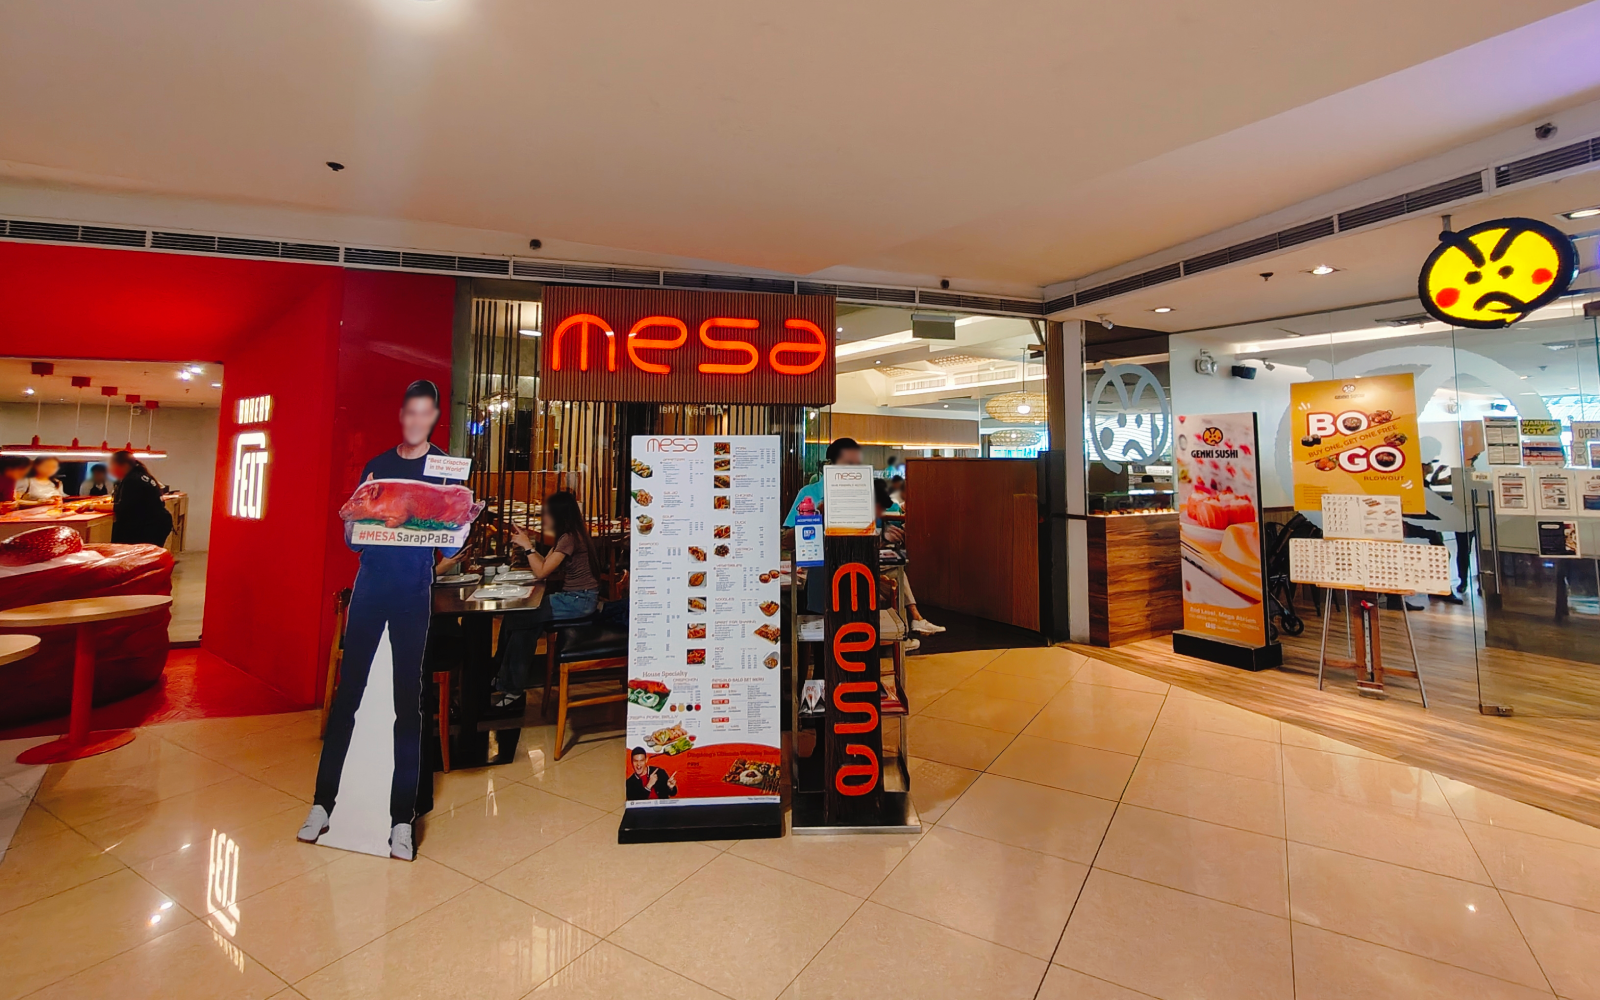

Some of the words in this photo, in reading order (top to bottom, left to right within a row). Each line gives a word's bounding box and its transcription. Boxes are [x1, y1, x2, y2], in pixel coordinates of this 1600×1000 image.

[552, 313, 827, 375] mesa
[1307, 410, 1370, 437] BO
[646, 438, 698, 452] mesa
[1191, 450, 1214, 458] GENKI
[1215, 450, 1238, 458] SUSHI
[1308, 448, 1322, 458] BUY
[1324, 444, 1343, 452] ONE,
[1344, 438, 1358, 446] GET
[1360, 432, 1376, 440] ONE
[1378, 425, 1398, 434] FREE
[1338, 445, 1406, 473] GO
[232, 432, 268, 519] FELT
[358, 530, 455, 544] #MESASarapPaBa
[662, 670, 688, 678] Specialty
[832, 562, 879, 796] mesa
